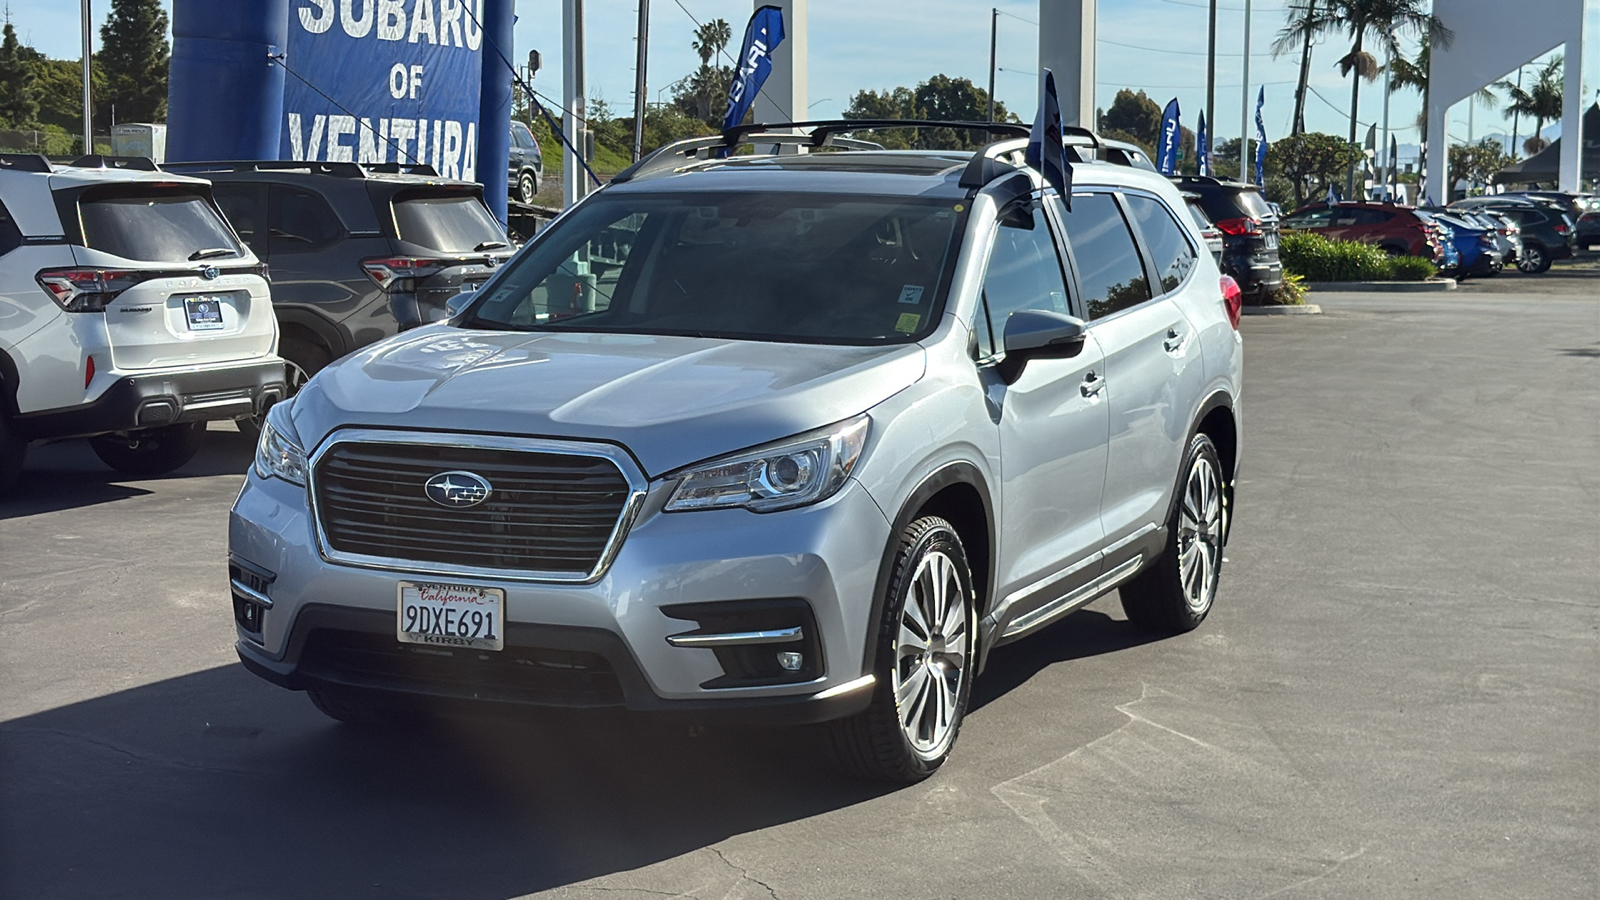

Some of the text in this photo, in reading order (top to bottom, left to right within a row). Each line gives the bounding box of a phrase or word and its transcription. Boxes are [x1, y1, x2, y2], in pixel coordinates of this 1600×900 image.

[298, 0, 482, 51] SUBARU
[389, 62, 424, 100] OF
[288, 112, 476, 184] VENTURA
[420, 588, 484, 606] California
[424, 583, 477, 593] VENTURA
[405, 605, 496, 640] 9DXE691
[424, 635, 475, 646] KIRBY
